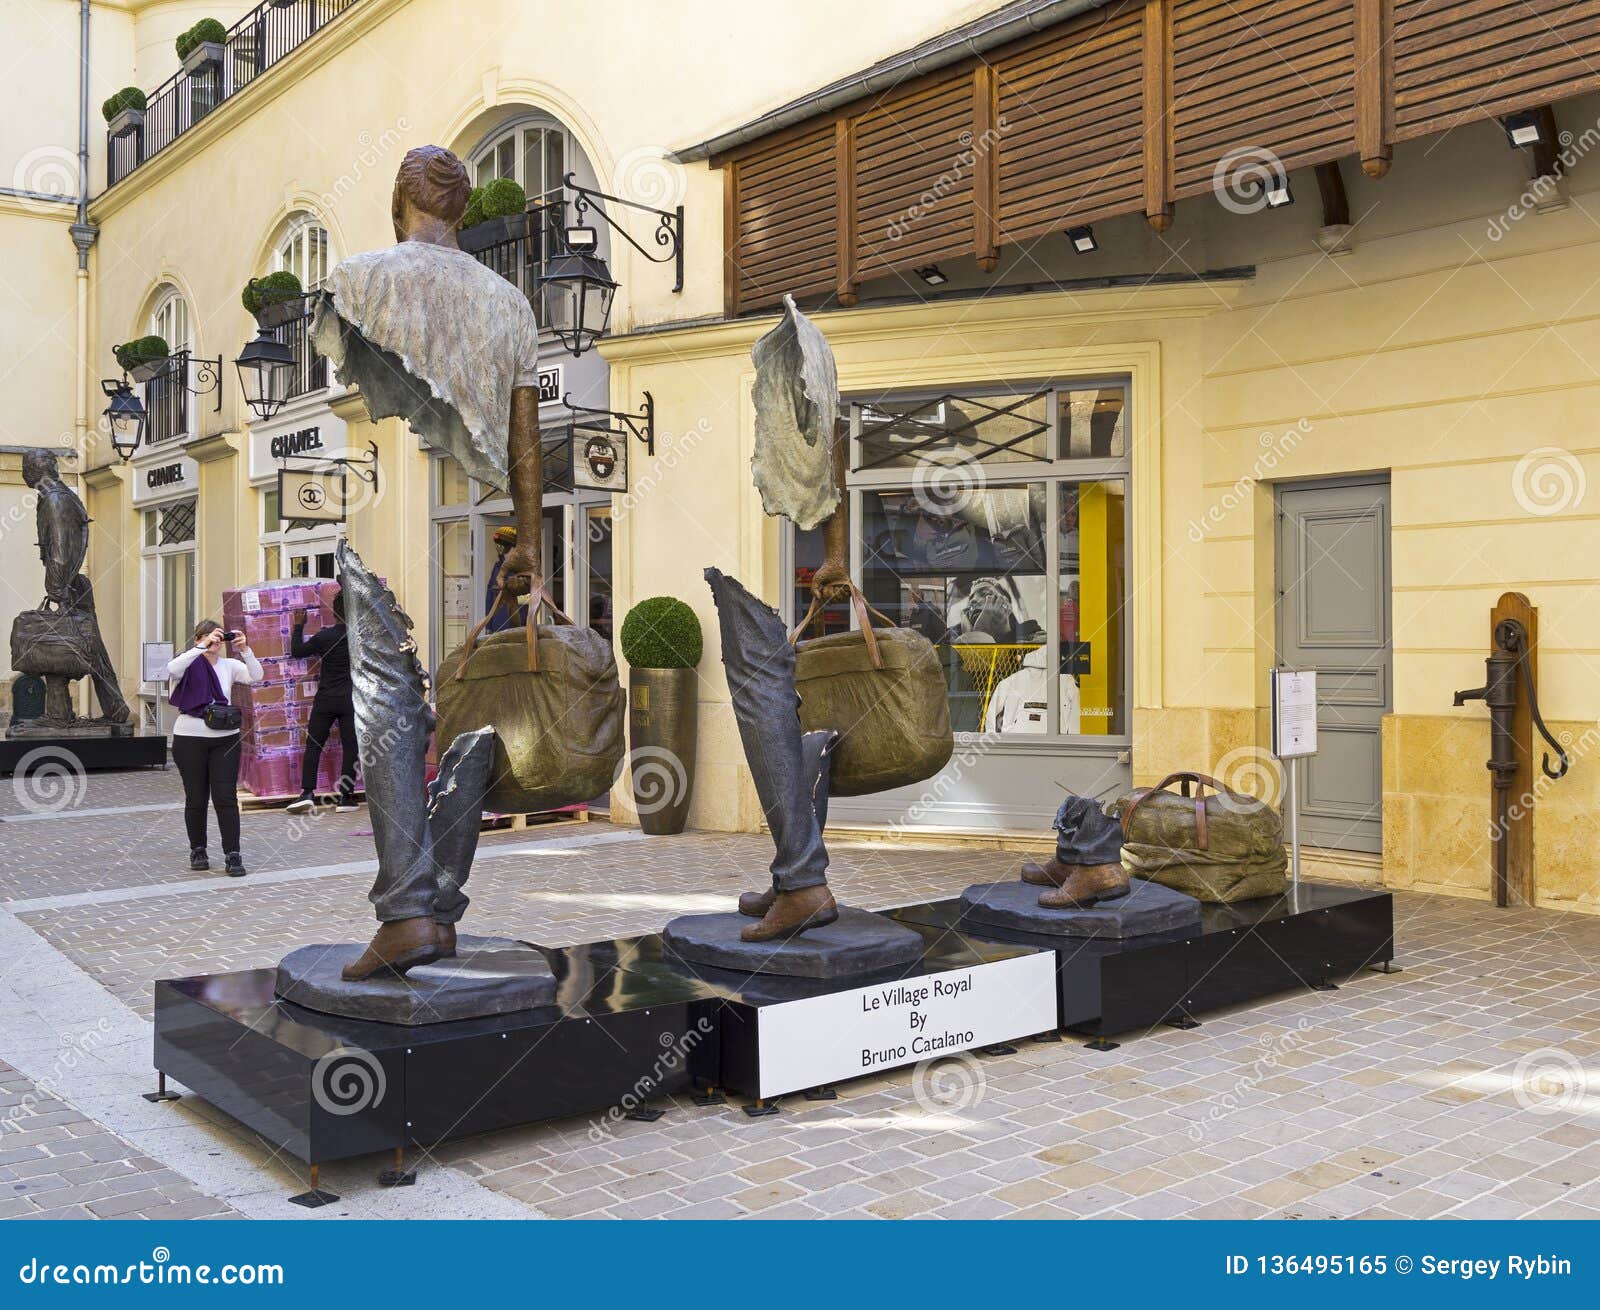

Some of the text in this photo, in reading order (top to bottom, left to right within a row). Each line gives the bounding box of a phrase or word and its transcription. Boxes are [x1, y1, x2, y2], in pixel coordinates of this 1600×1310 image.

[270, 426, 323, 459] CHANEL
[147, 463, 185, 488] CHANEL
[863, 974, 972, 1012] Le Village Royal
[910, 1011, 927, 1033] By
[862, 1031, 974, 1067] Bruno Catalano
